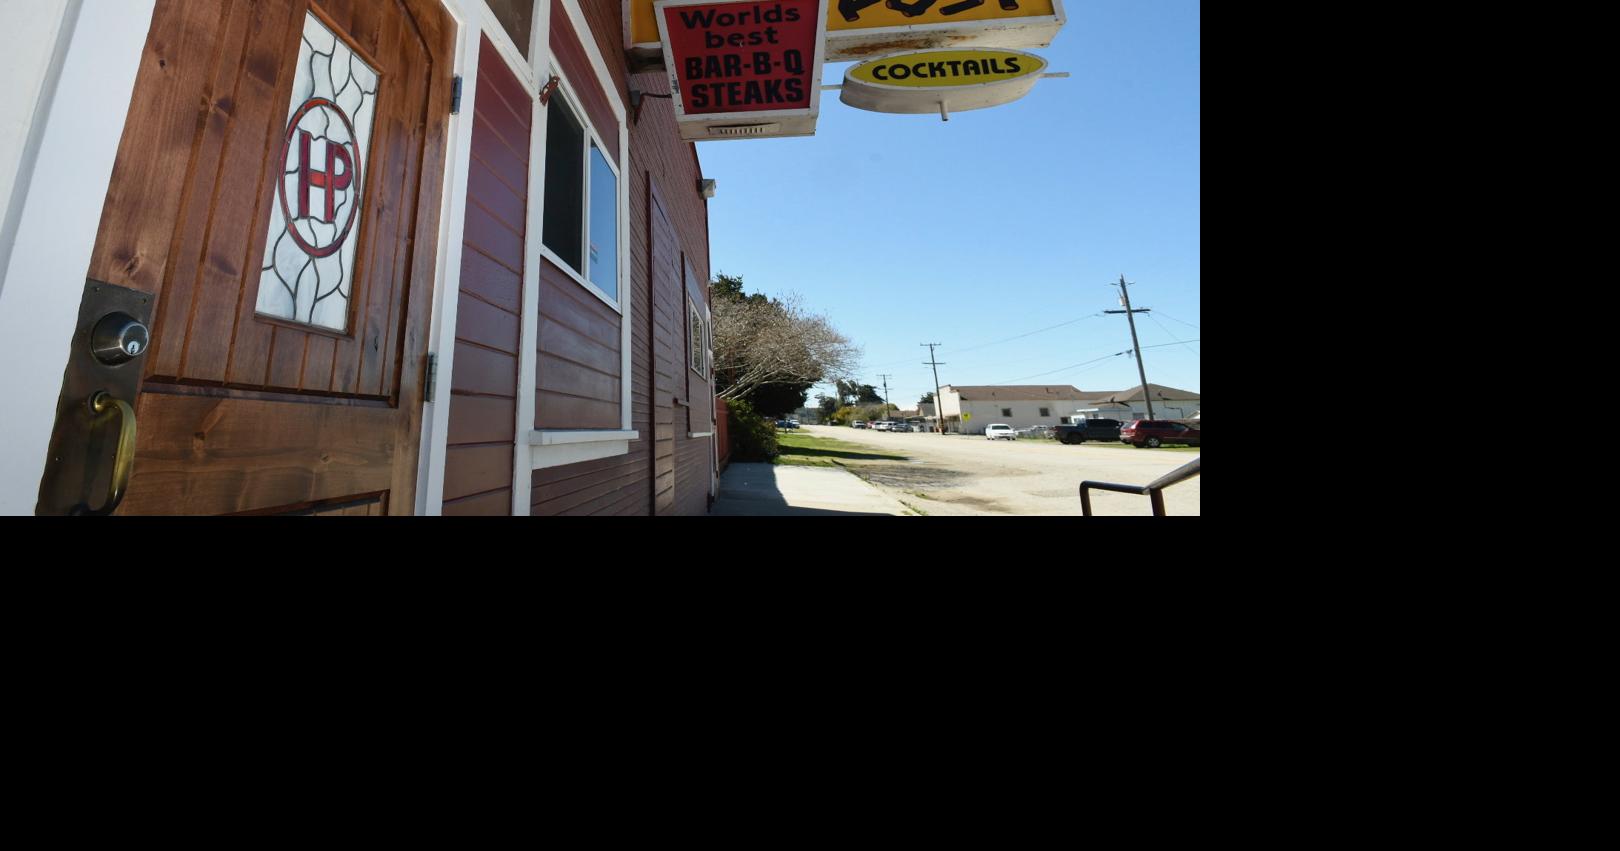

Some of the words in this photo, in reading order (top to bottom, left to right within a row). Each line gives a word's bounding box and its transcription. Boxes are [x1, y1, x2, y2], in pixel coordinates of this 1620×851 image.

[679, 4, 801, 29] Worlds
[705, 27, 779, 49] best
[685, 49, 805, 80] BAR-B-Q
[872, 57, 1021, 80] COCKTAILS
[691, 78, 804, 108] STEAKS
